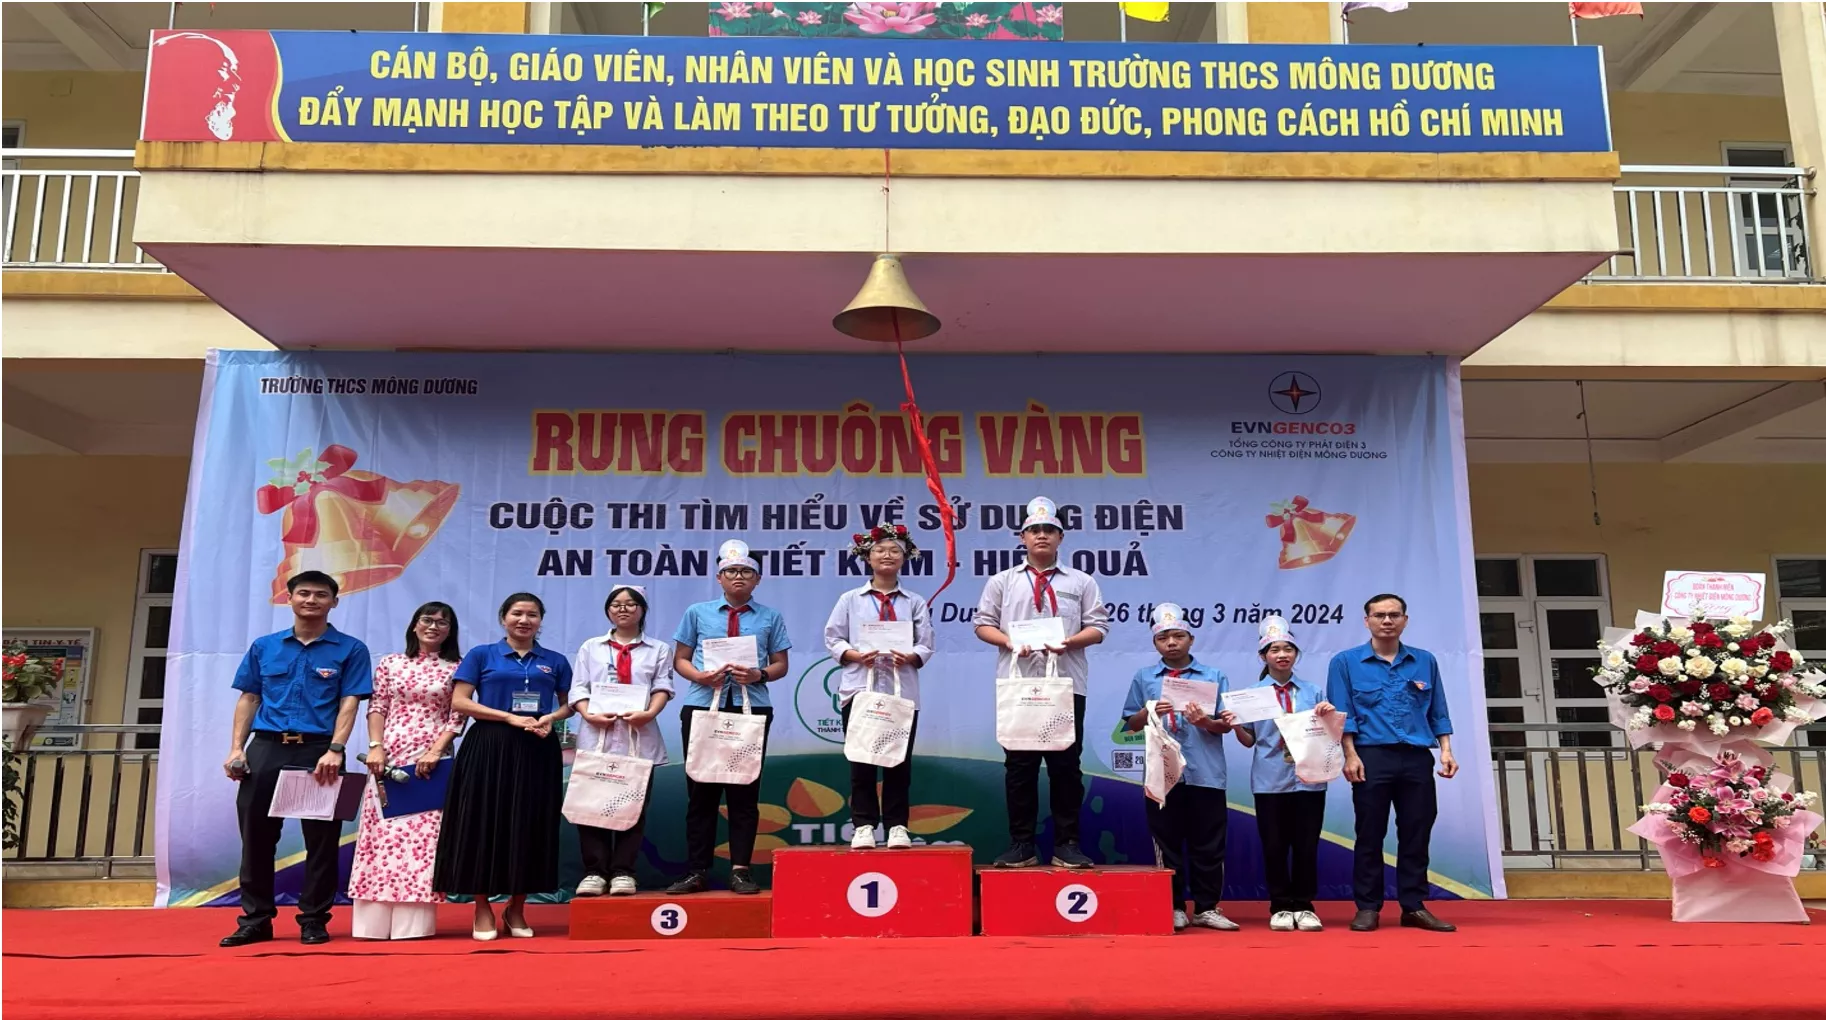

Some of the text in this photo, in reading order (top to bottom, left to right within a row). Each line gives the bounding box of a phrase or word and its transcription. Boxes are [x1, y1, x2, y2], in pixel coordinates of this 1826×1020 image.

[369, 44, 1496, 92] CÁN BỘ, GIÁO VIÊN, NHÂN VIÊN VÀ HỌC SINH TRƯỜNG THCS MÔNG DƯƠNG
[298, 84, 1564, 141] ĐẨY MẠNH HỌC TẬP VÀ LÀM THEO TƯ TƯỞNG, ĐẠO ĐỨC, PHONG CÁCH HỒ CHÍ MINH
[260, 374, 478, 395] TRƯỜNG THCS MÔNG DƯƠNG
[531, 401, 1144, 476] RUNG CHUÔNG VÀNG
[1231, 421, 1356, 435] EVNGENCO3
[1210, 448, 1243, 458] CÔNG
[1244, 450, 1256, 458] TY
[1259, 449, 1286, 460] NHIỆT
[1288, 449, 1312, 460] ĐIỆN
[1314, 450, 1347, 459] MÔNG
[1228, 437, 1260, 448] TỔNG
[1261, 438, 1293, 449] CÔNG
[1295, 441, 1308, 449] TY
[1308, 439, 1333, 449] PHÁT
[1361, 441, 1366, 450] 3
[489, 492, 1184, 537] CUỘC THI TÌM HIỂU VỀ SỬ DỤG ĐIỆN
[537, 549, 593, 577] AN
[606, 543, 709, 577] TOÀN
[1072, 540, 1149, 577] QUẢ
[1103, 602, 1129, 623] 26
[1212, 602, 1226, 623] 3
[1291, 603, 1344, 625] 2024
[860, 880, 879, 908] 1
[1067, 891, 1089, 915] 2
[659, 909, 679, 929] 3
